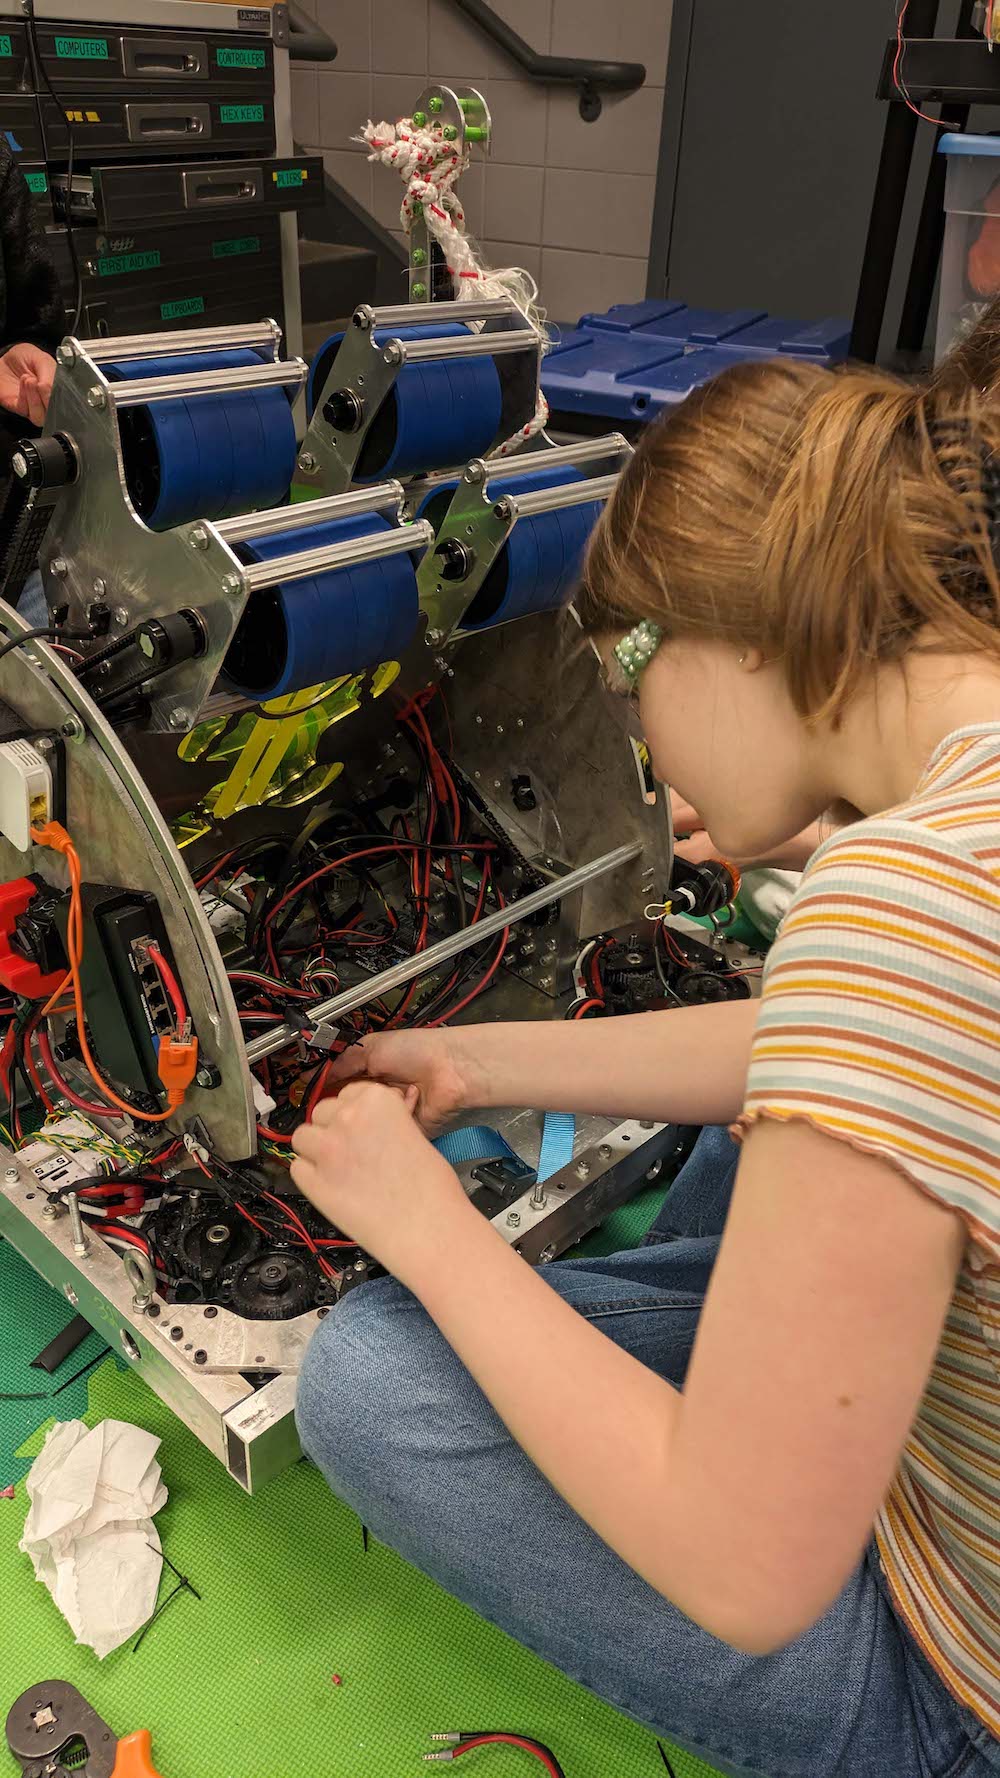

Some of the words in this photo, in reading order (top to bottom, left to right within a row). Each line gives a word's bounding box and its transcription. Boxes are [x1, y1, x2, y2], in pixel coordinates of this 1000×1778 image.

[58, 40, 107, 57] COMPUTERS
[218, 51, 265, 66] CONTROLLERS
[222, 108, 240, 121] HEX
[241, 107, 263, 120] KEYS
[277, 171, 302, 185] PLIERS
[100, 257, 126, 273] FIRST
[129, 255, 144, 268] AID
[144, 252, 159, 265] KIT
[163, 299, 203, 317] CLIPBOARDS
